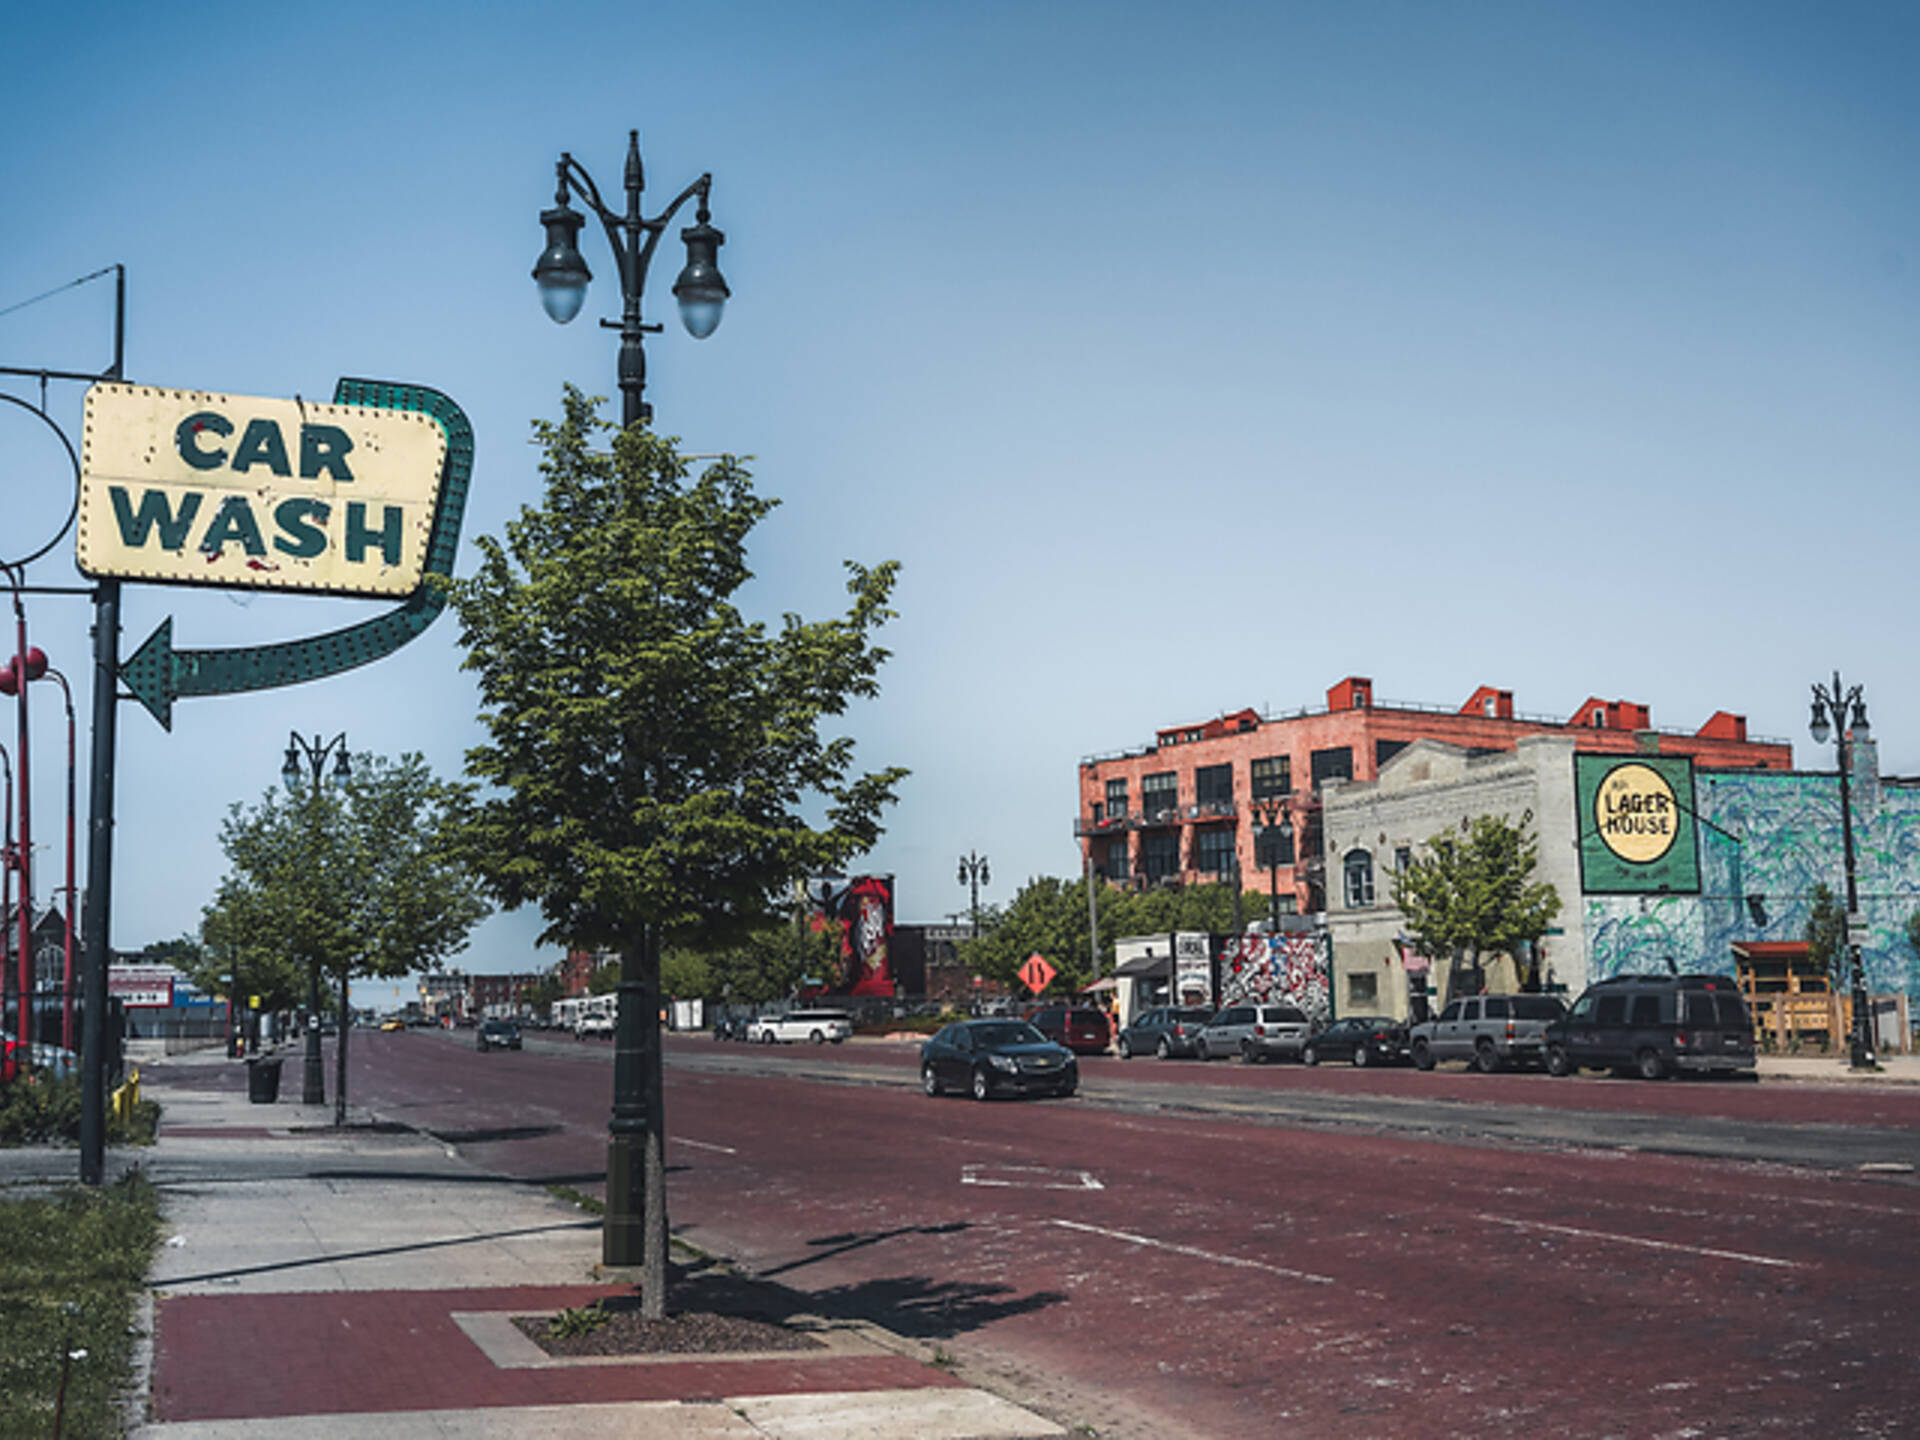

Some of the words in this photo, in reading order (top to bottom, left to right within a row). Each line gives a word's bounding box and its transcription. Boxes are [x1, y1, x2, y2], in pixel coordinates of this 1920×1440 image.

[174, 412, 355, 482] CAR
[108, 486, 403, 567] WASH
[1604, 793, 1669, 813] LAGER
[1606, 815, 1671, 835] HOUSE
